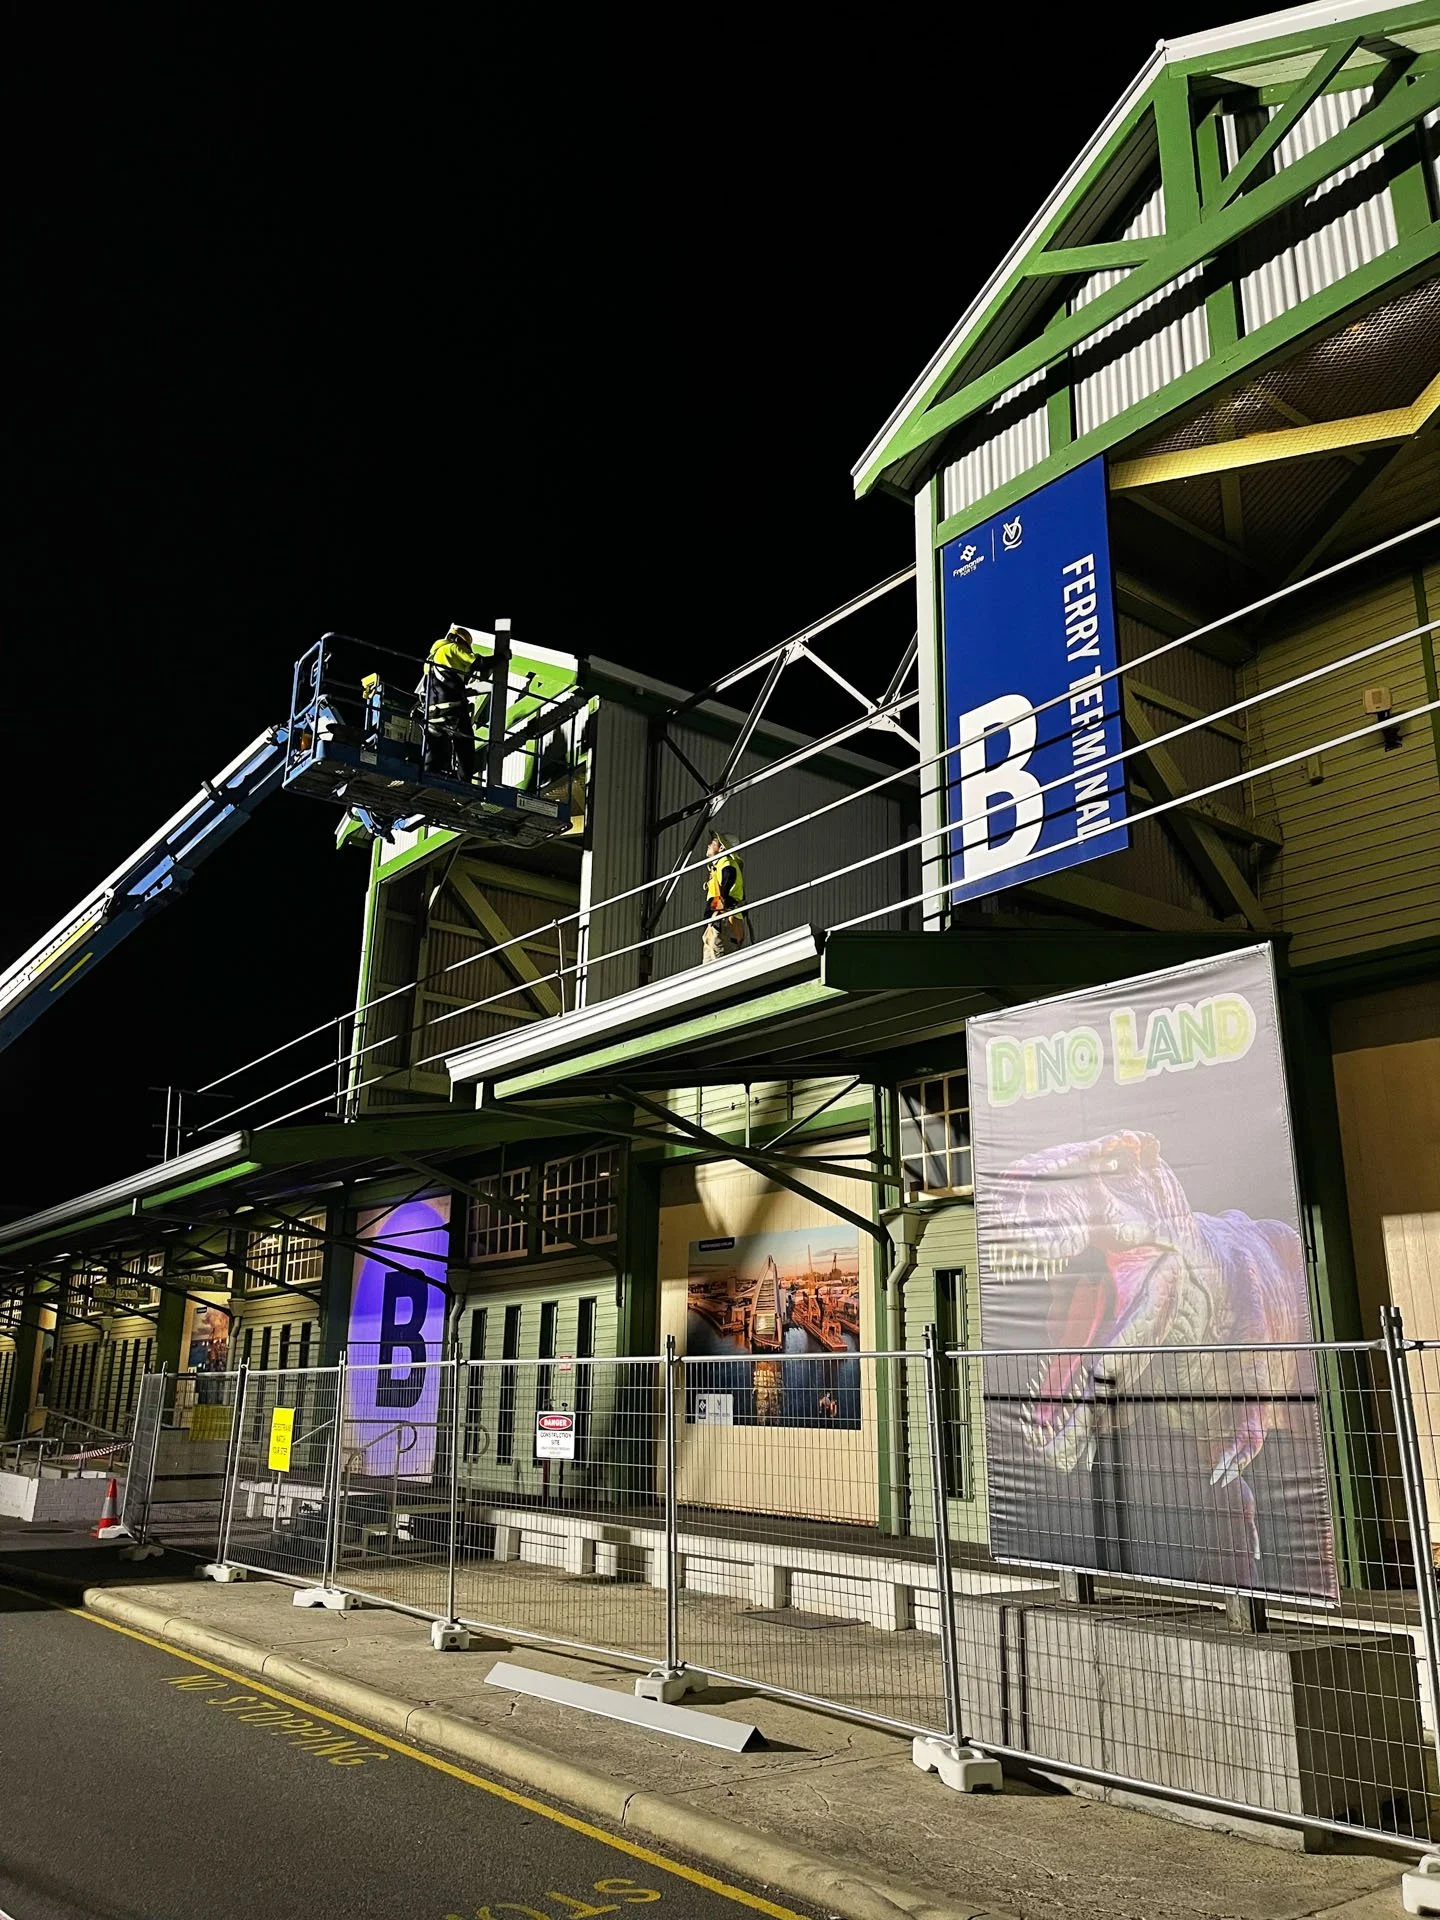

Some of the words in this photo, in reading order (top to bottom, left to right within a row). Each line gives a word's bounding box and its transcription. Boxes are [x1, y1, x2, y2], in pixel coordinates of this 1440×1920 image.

[1062, 552, 1101, 662] FERRY
[959, 694, 1044, 882] B
[1069, 665, 1112, 846] TERMNAL
[988, 1028, 1102, 1106] DINO
[1111, 993, 1254, 1084] LAND
[376, 1269, 429, 1409] B
[543, 1418, 567, 1426] DANGER
[160, 1674, 229, 1692] NO
[206, 1696, 389, 1766] STOPPING
